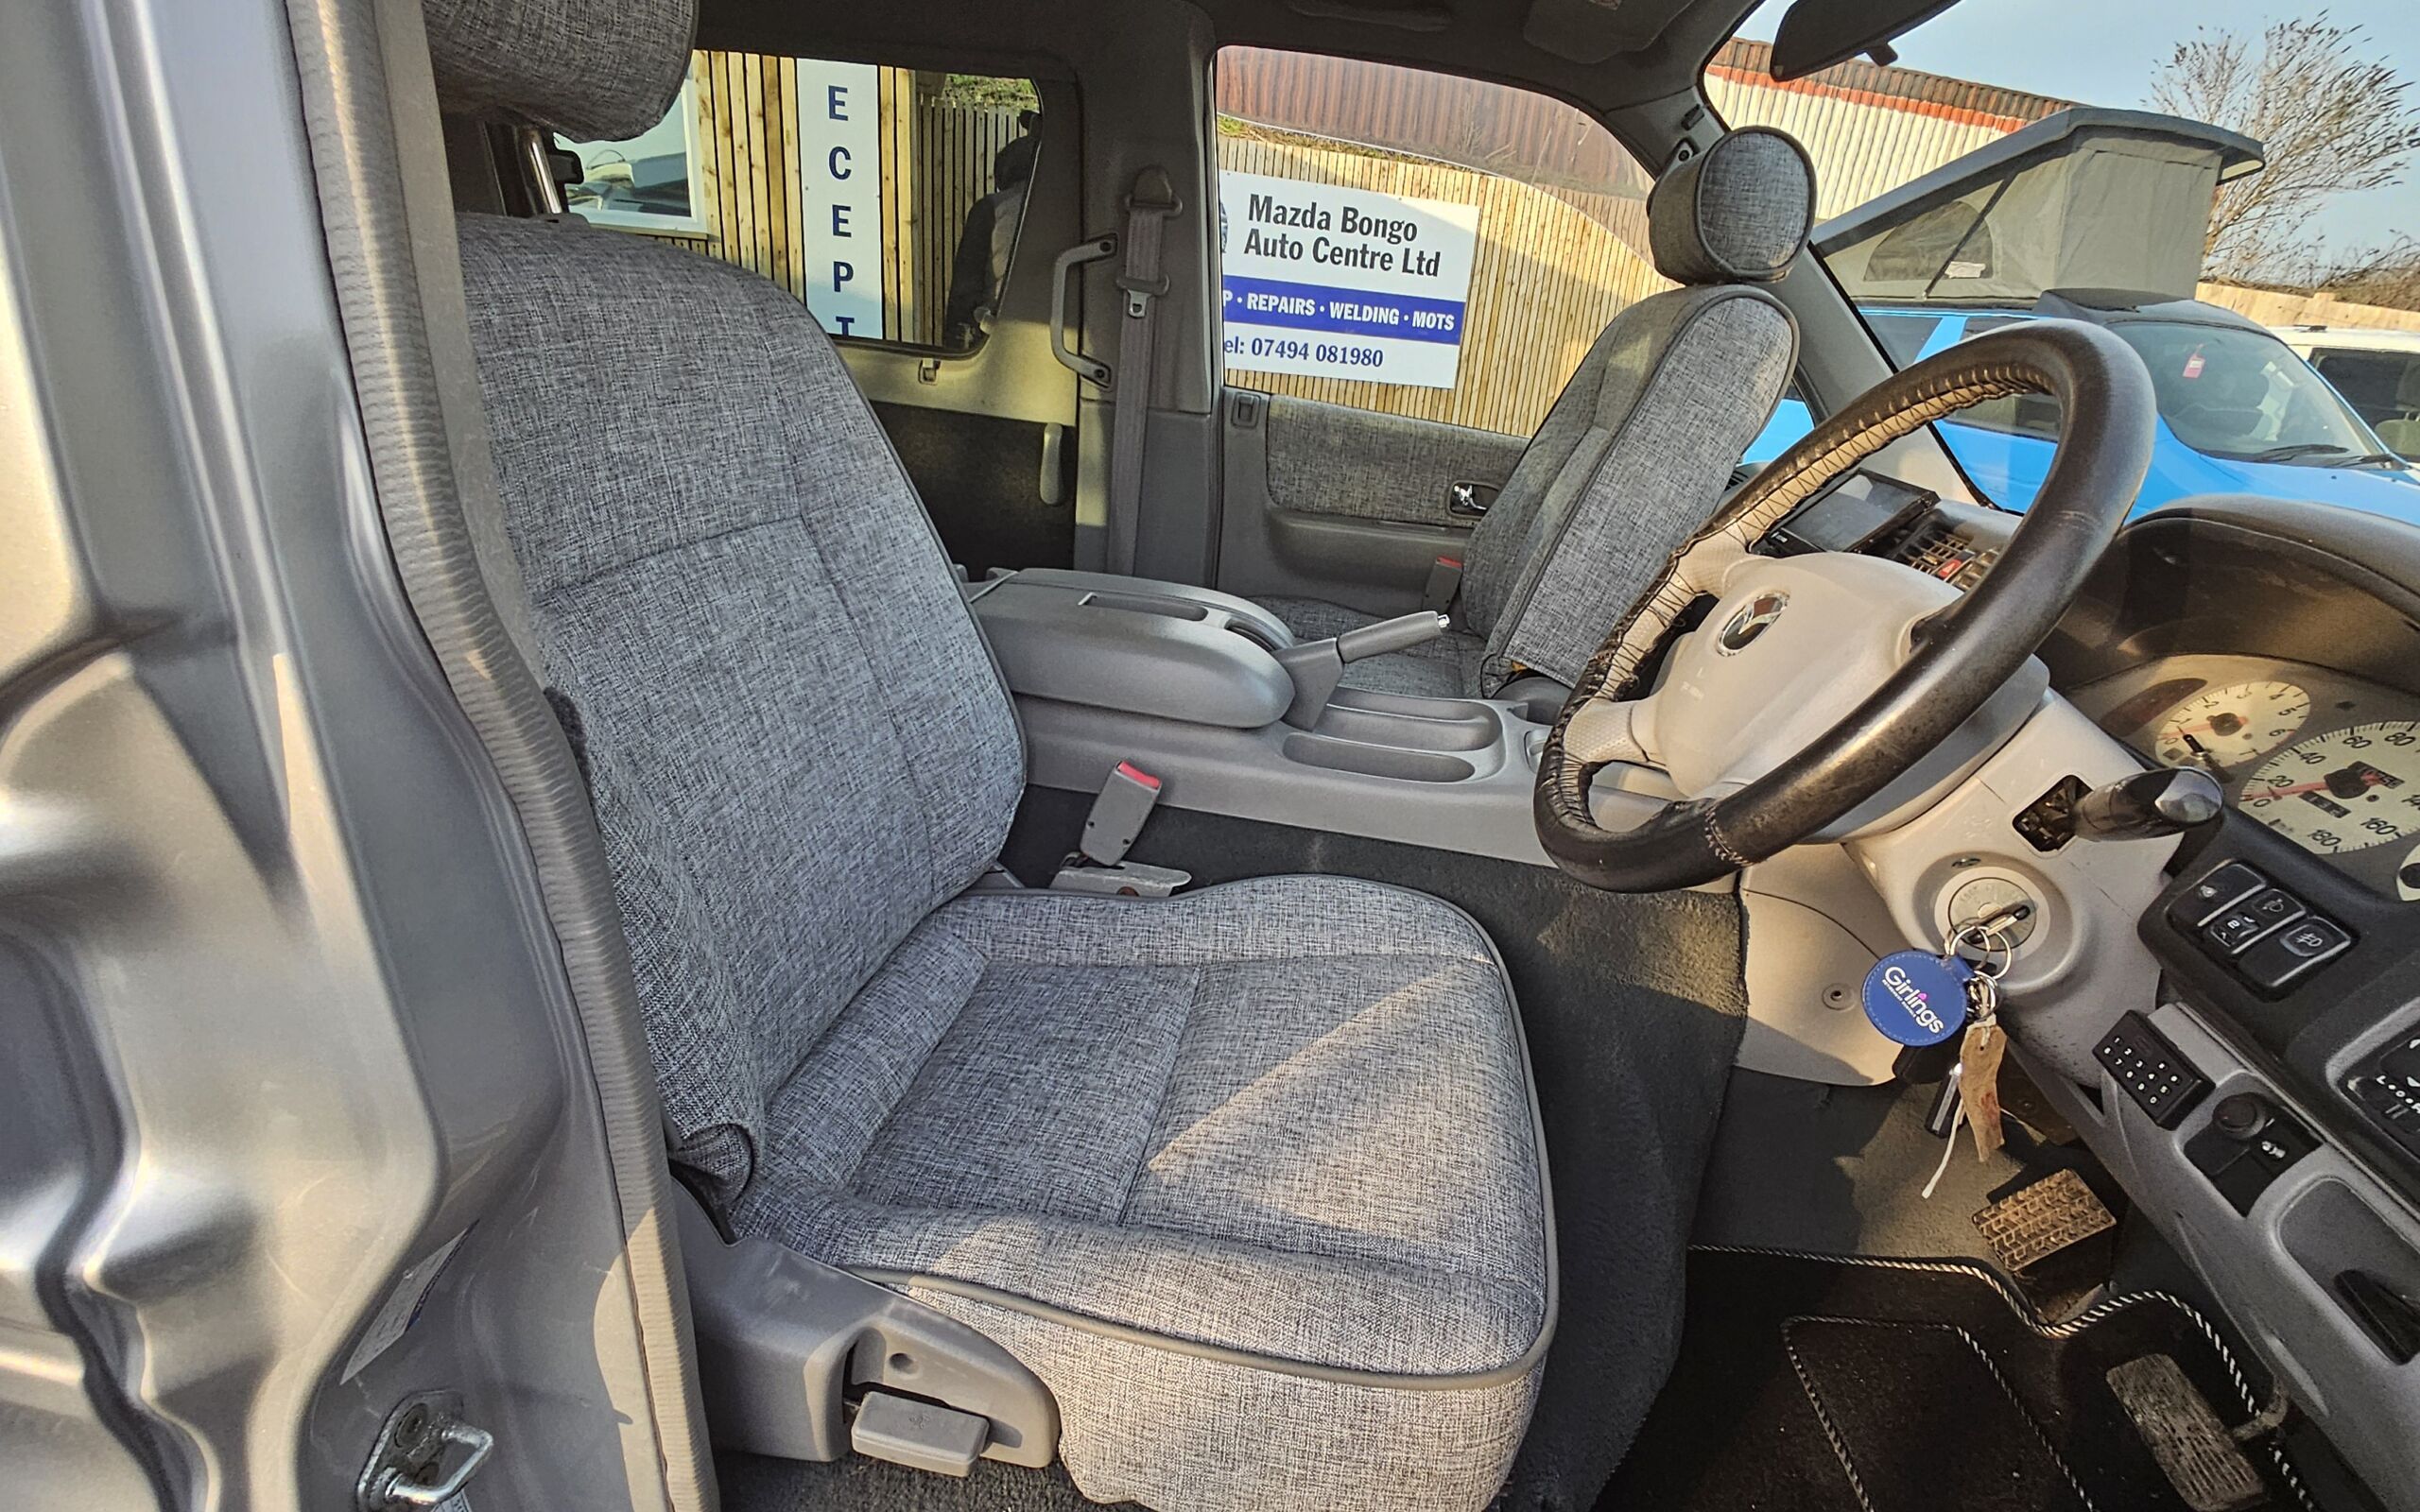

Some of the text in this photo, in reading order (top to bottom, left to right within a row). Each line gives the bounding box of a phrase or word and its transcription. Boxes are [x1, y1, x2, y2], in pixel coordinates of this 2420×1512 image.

[1248, 193, 1418, 245] Mazda Bongo
[1244, 229, 1441, 277] Auto Centre Ltd
[1247, 292, 1316, 317] REPAIRS
[1329, 301, 1399, 325] WELDING
[1412, 311, 1455, 331] MOTS
[1251, 337, 1310, 359] 07494
[1315, 344, 1384, 368] 081980
[2204, 700, 2221, 710] 2
[2278, 707, 2298, 717] 5
[2269, 728, 2287, 737] 6
[2384, 731, 2416, 747] 80
[2342, 735, 2373, 749] 60
[2300, 751, 2326, 765] 40
[2268, 775, 2295, 788] 20
[2253, 799, 2272, 808] 0
[2360, 817, 2398, 835] 160
[2308, 829, 2342, 847] 180
[1885, 966, 1945, 1034] Girlings
